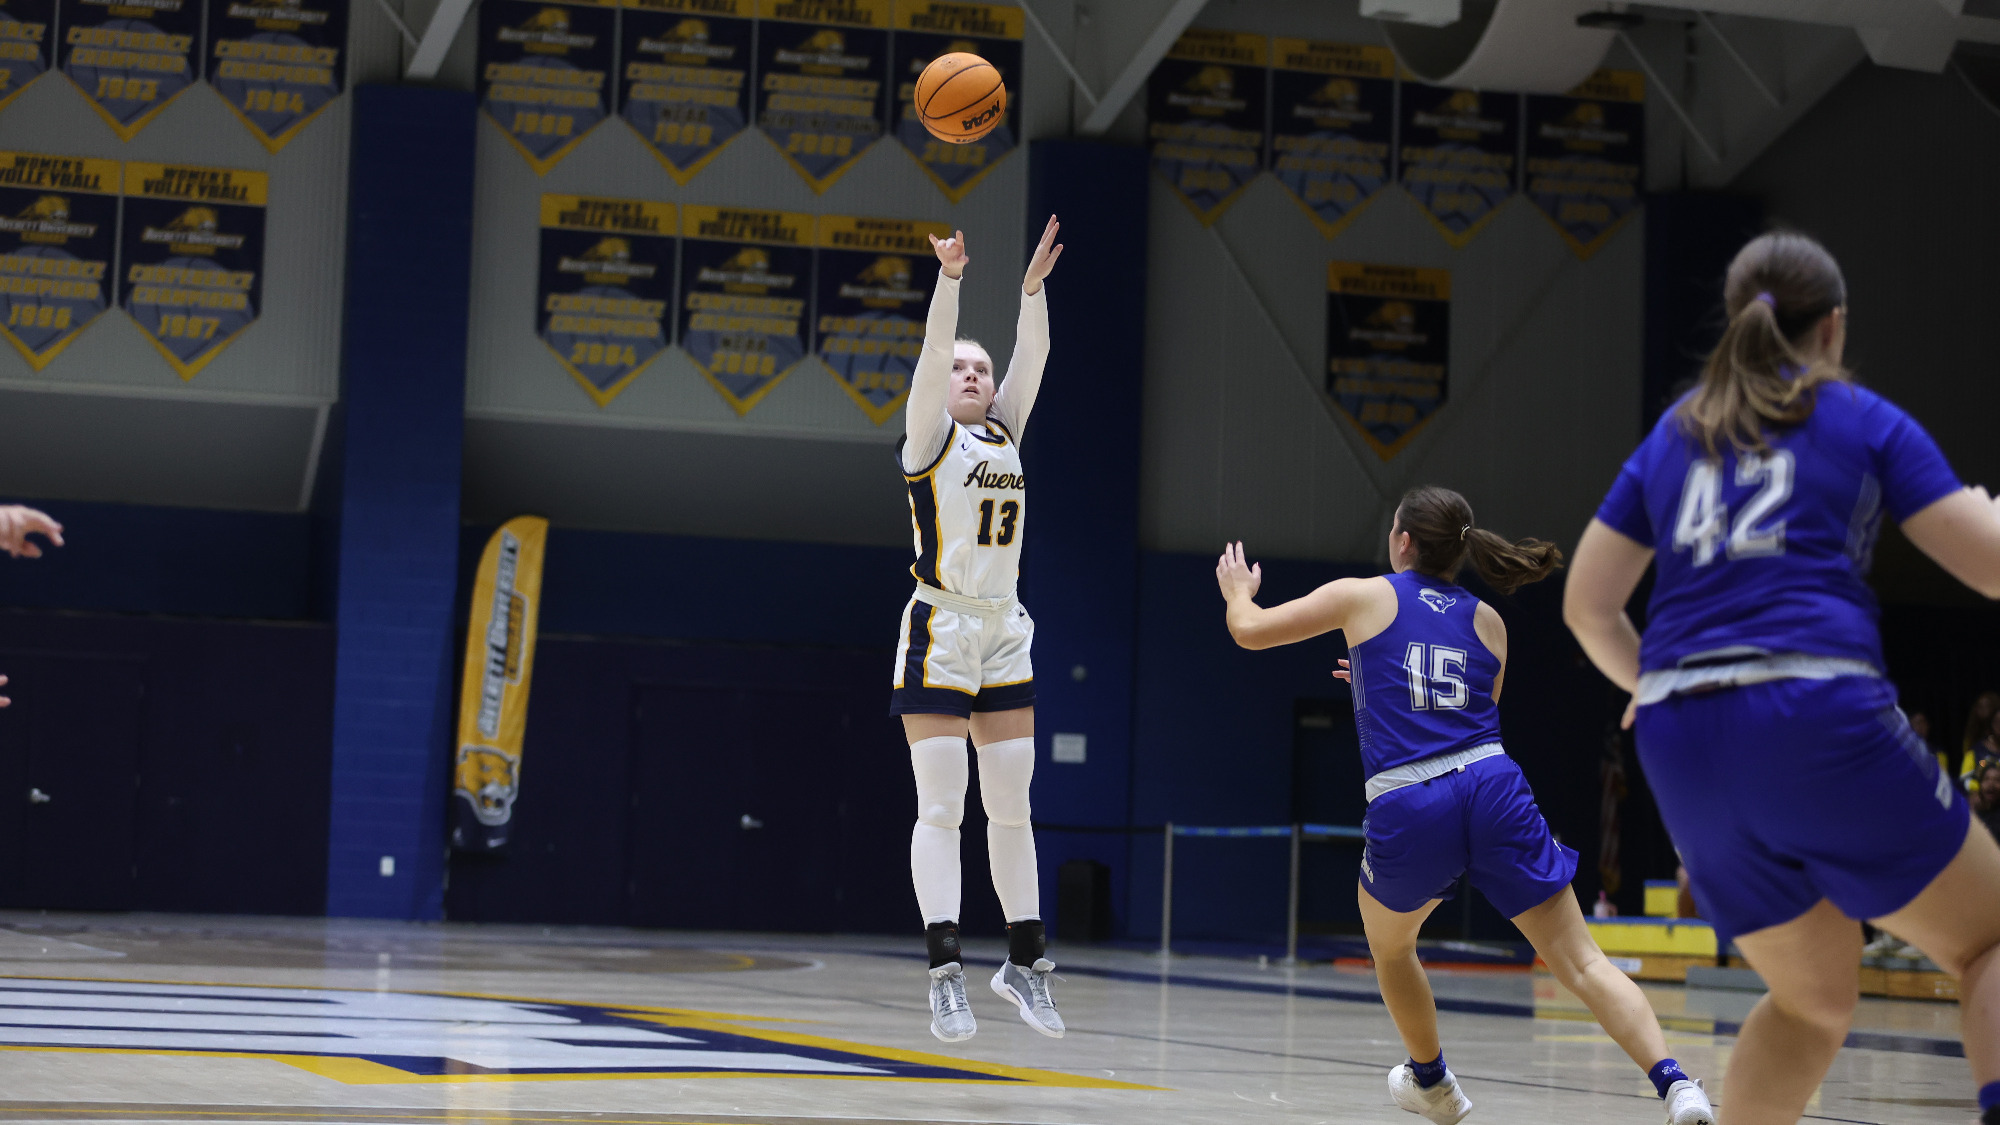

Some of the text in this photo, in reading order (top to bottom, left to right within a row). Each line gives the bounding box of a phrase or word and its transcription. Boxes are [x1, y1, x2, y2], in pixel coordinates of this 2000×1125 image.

[71, 47, 187, 73] CHAMPIONS
[962, 99, 1000, 131] NCAA
[0, 254, 107, 280] NFERENCE
[0, 276, 101, 299] HAMPIONS
[132, 286, 249, 310] CHAMPIONS
[158, 314, 220, 340] 1997
[963, 460, 1024, 490] Avere
[1672, 448, 1795, 567] 42
[977, 498, 1020, 547] 13
[1402, 641, 1469, 712] 15
